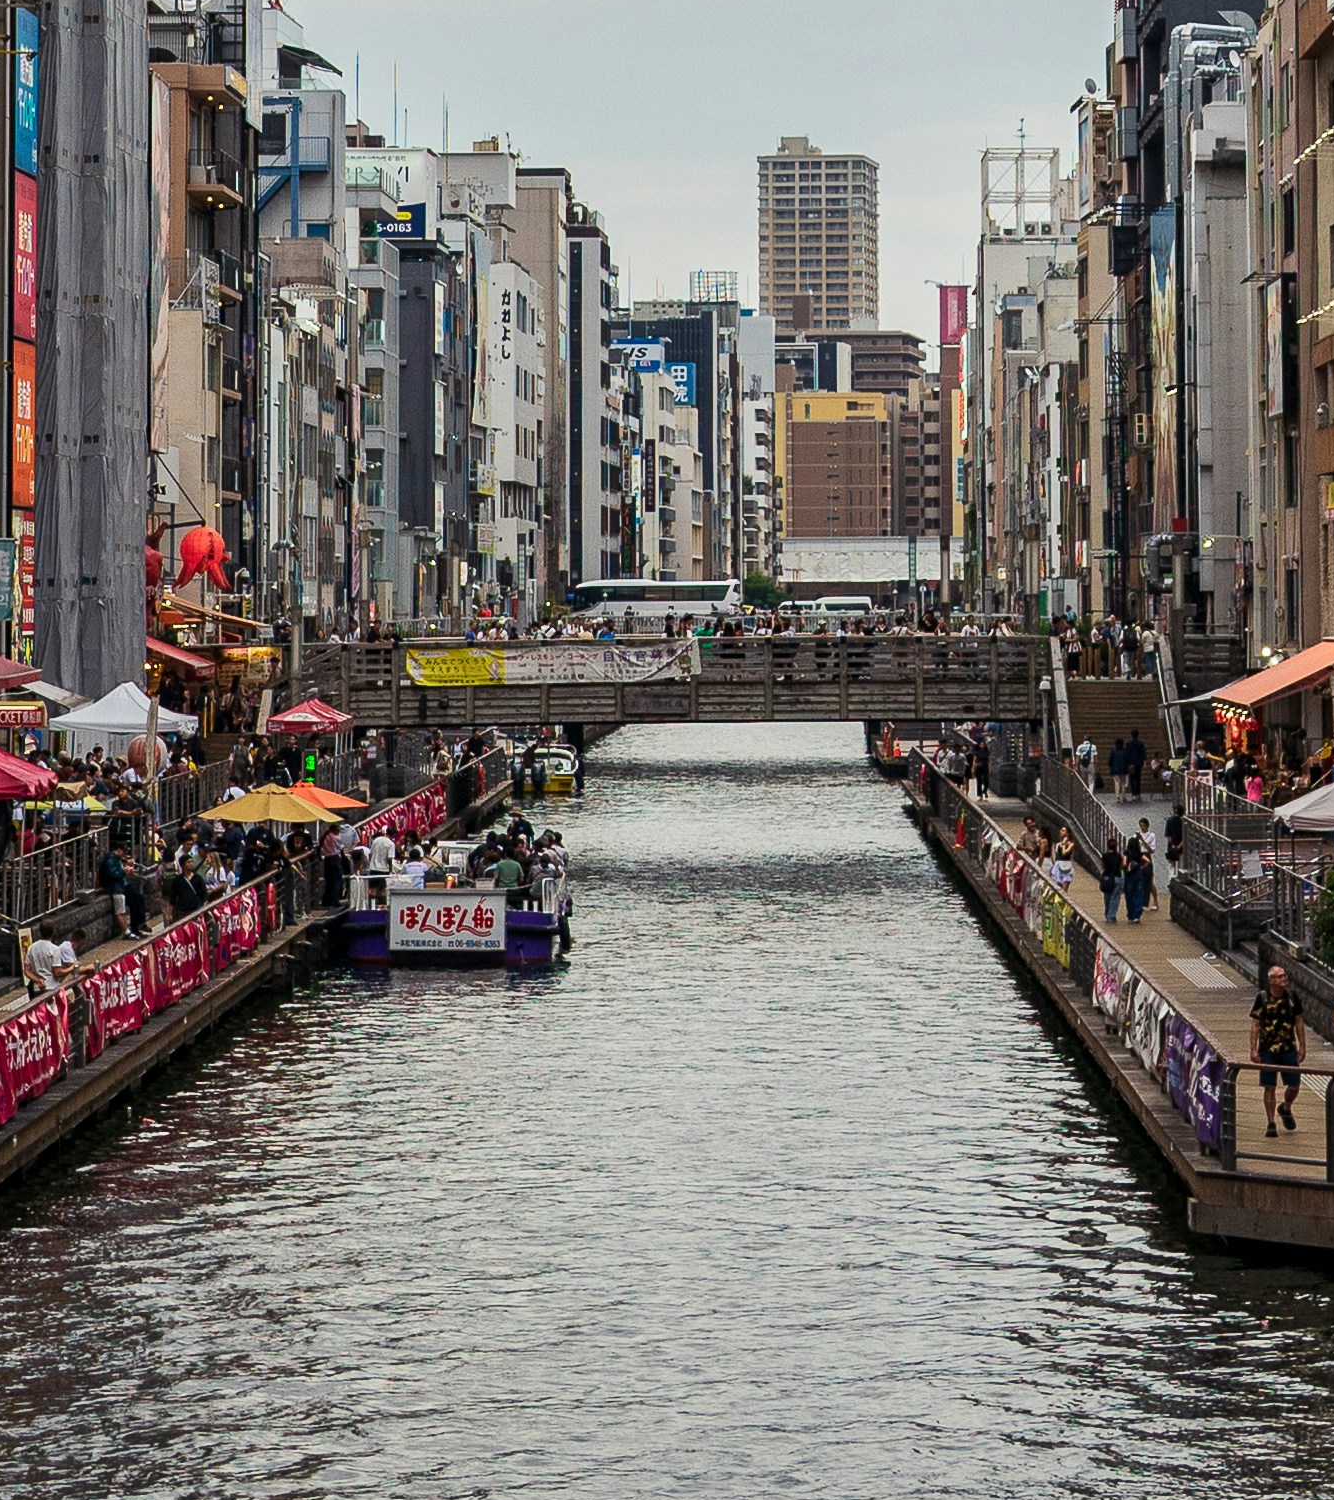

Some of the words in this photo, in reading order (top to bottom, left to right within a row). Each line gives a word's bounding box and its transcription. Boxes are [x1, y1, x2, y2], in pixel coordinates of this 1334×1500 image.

[399, 903, 495, 937] ぽんぽん船
